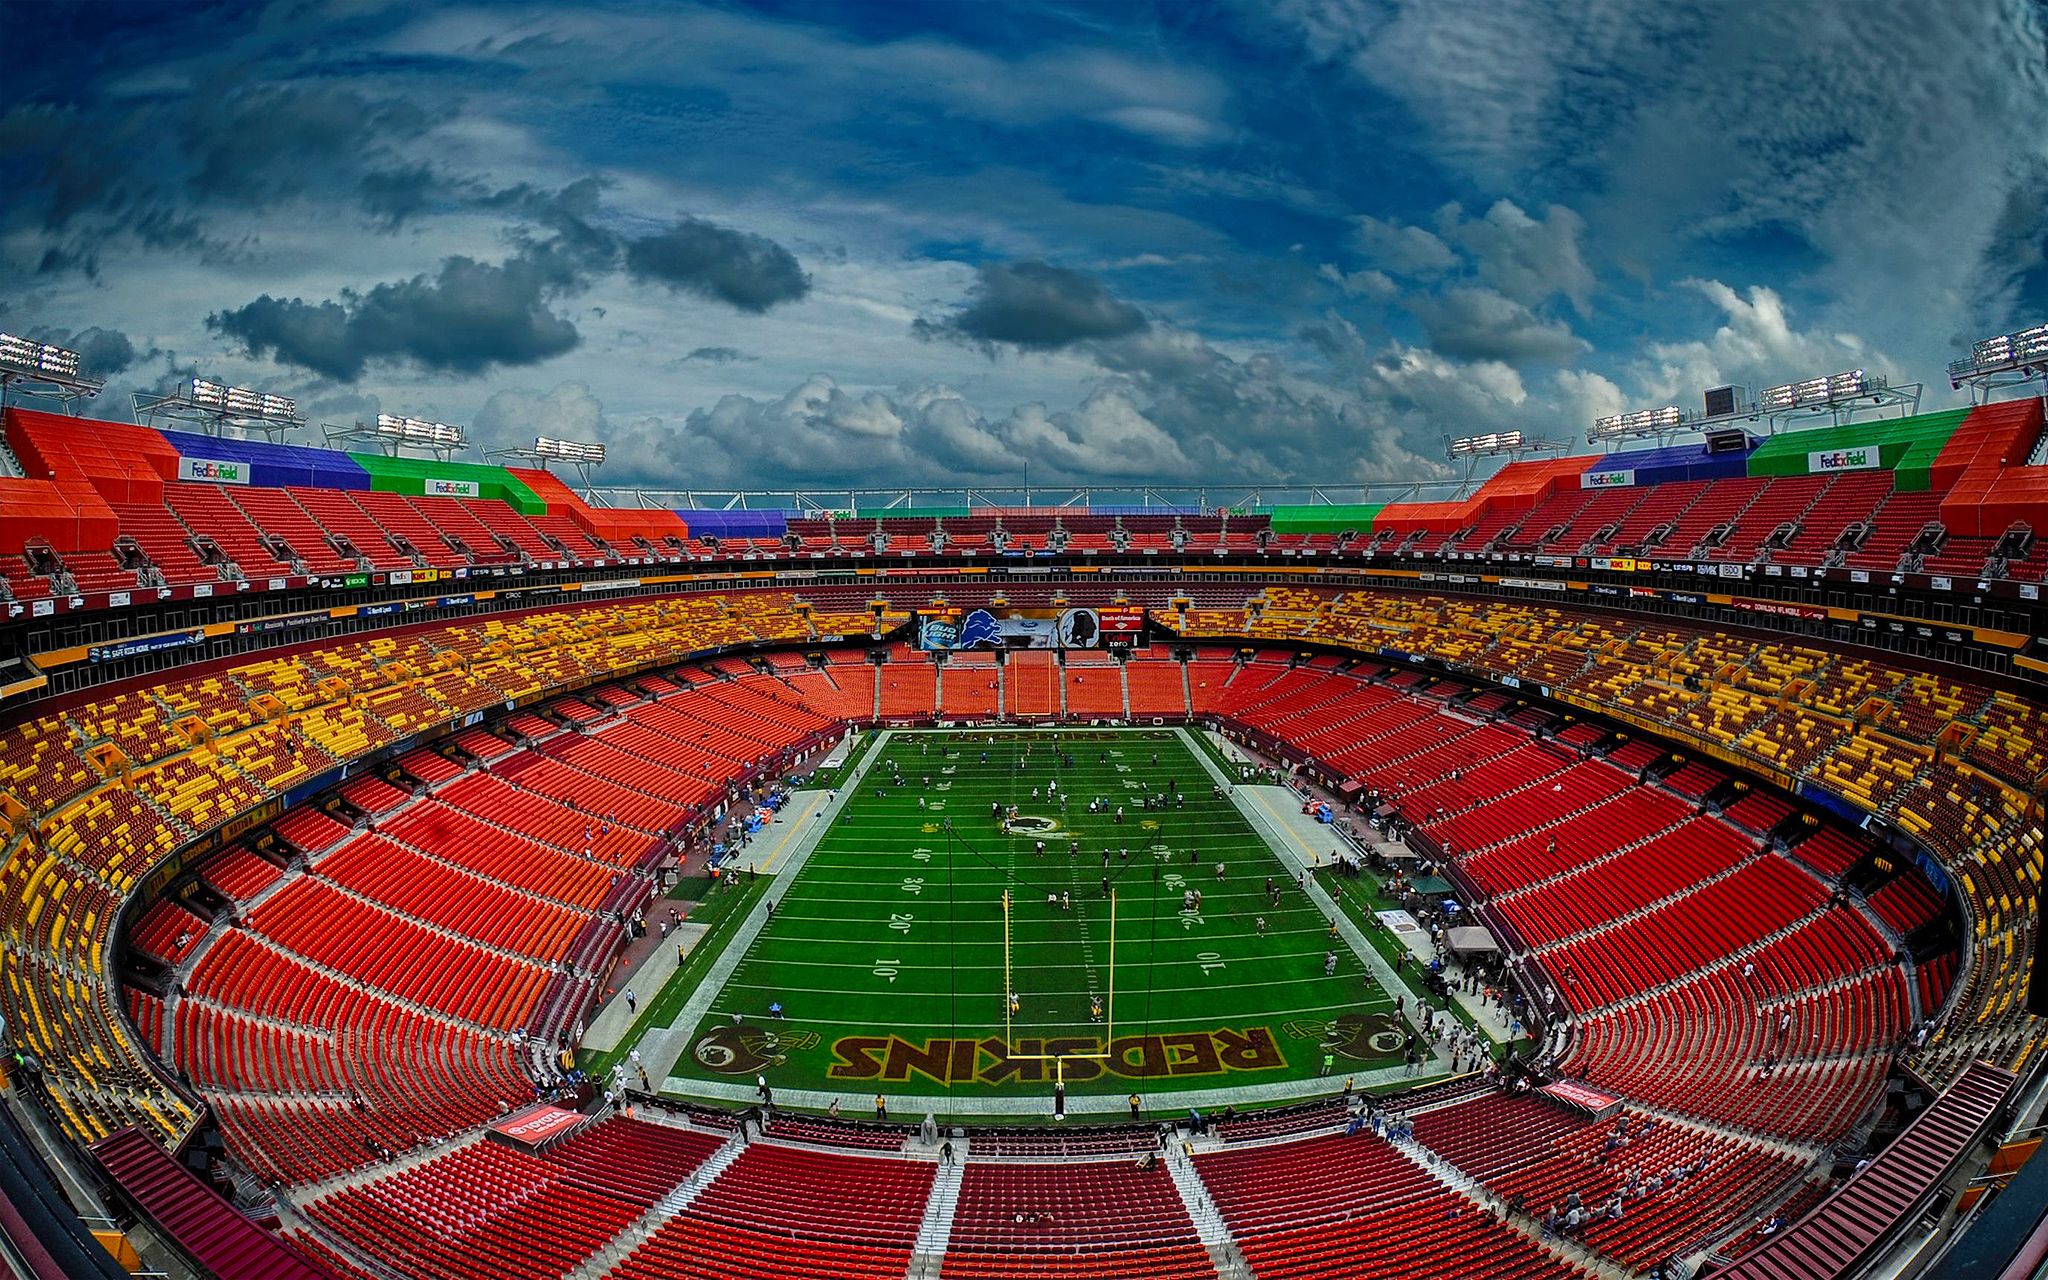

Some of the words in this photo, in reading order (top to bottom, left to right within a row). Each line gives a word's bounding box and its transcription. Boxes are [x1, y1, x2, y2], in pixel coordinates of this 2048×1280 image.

[1820, 450, 1867, 469] FedExField
[191, 461, 238, 480] FedExField
[1589, 472, 1625, 486] FedExField
[435, 482, 470, 494] FedExField
[925, 631, 957, 640] LIGHT
[929, 624, 957, 634] BUD
[111, 648, 124, 658] SAFE
[888, 913, 914, 930] 20
[872, 958, 901, 976] 10
[1196, 952, 1226, 970] 10
[826, 1026, 1289, 1087] REDSKINS
[522, 1111, 566, 1130] TOYOTA
